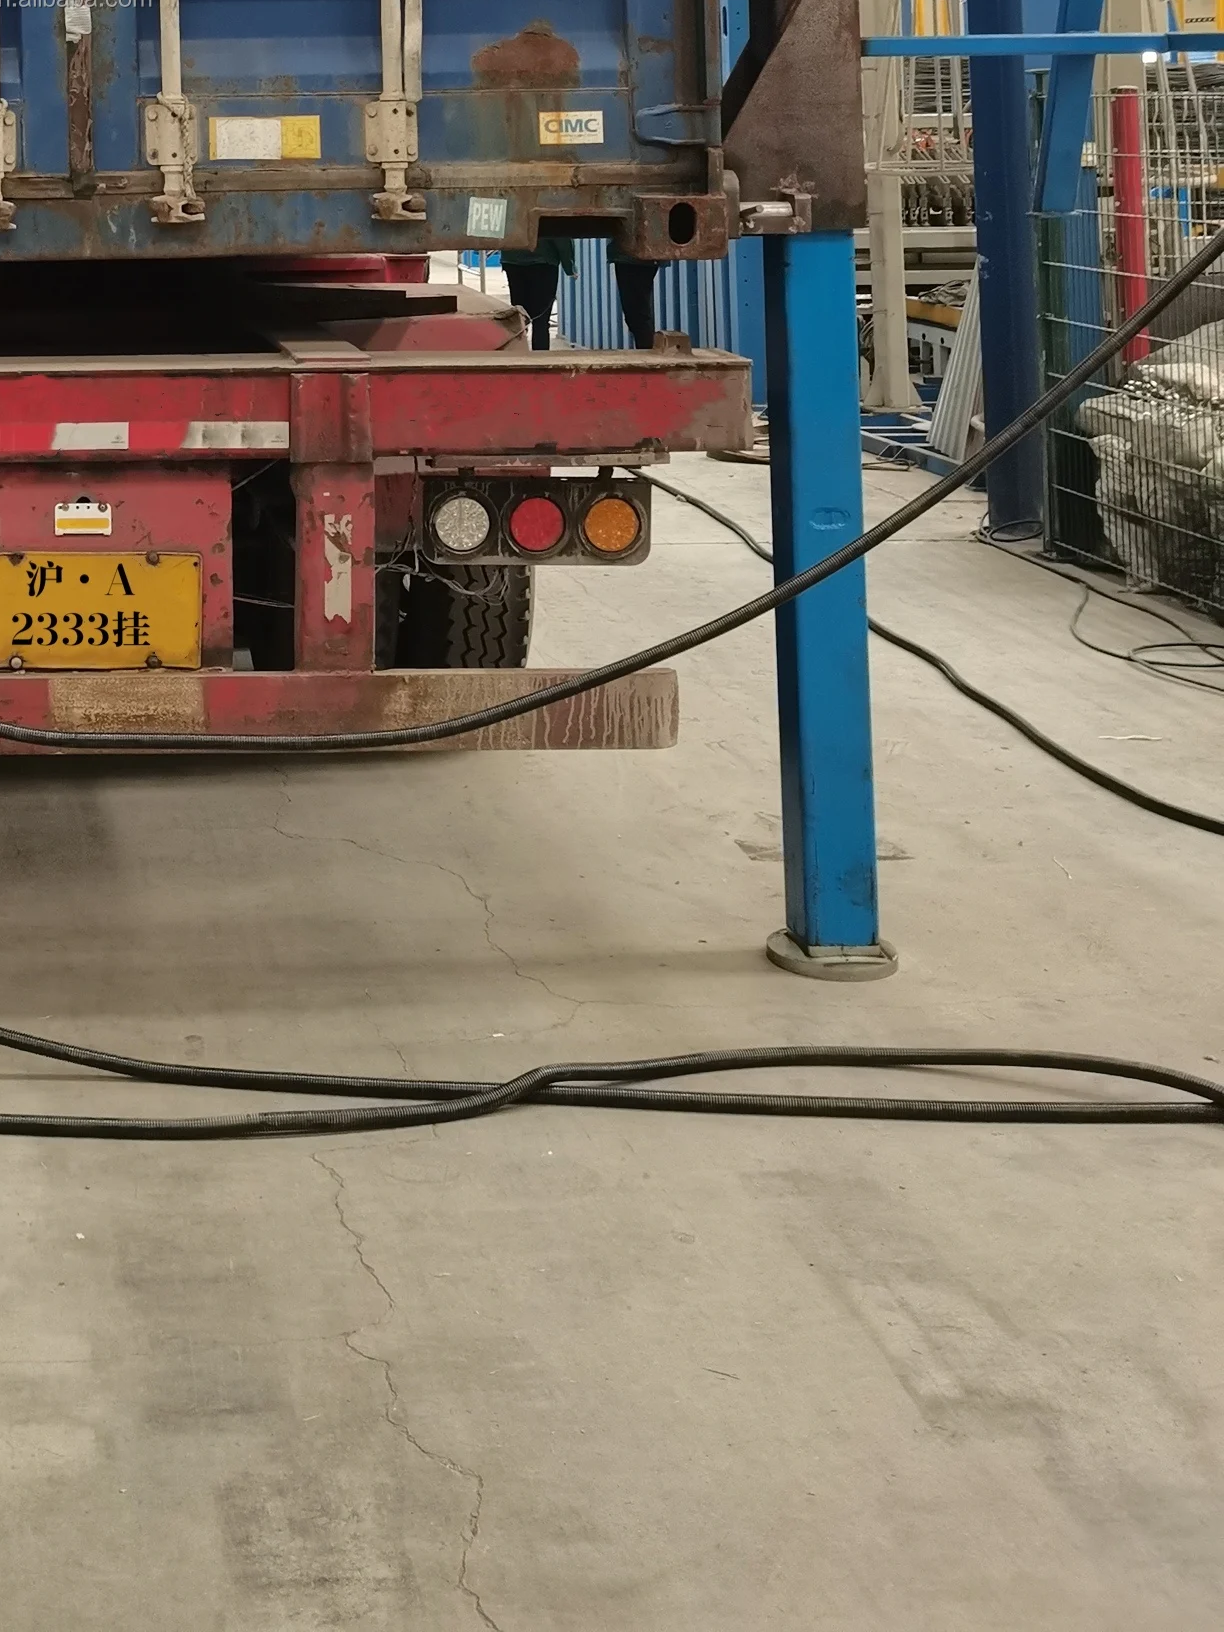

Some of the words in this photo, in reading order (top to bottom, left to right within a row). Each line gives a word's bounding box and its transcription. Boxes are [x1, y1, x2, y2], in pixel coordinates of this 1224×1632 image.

[544, 118, 598, 134] CIMC
[472, 201, 504, 232] PEW
[11, 610, 151, 648] 2333挂
